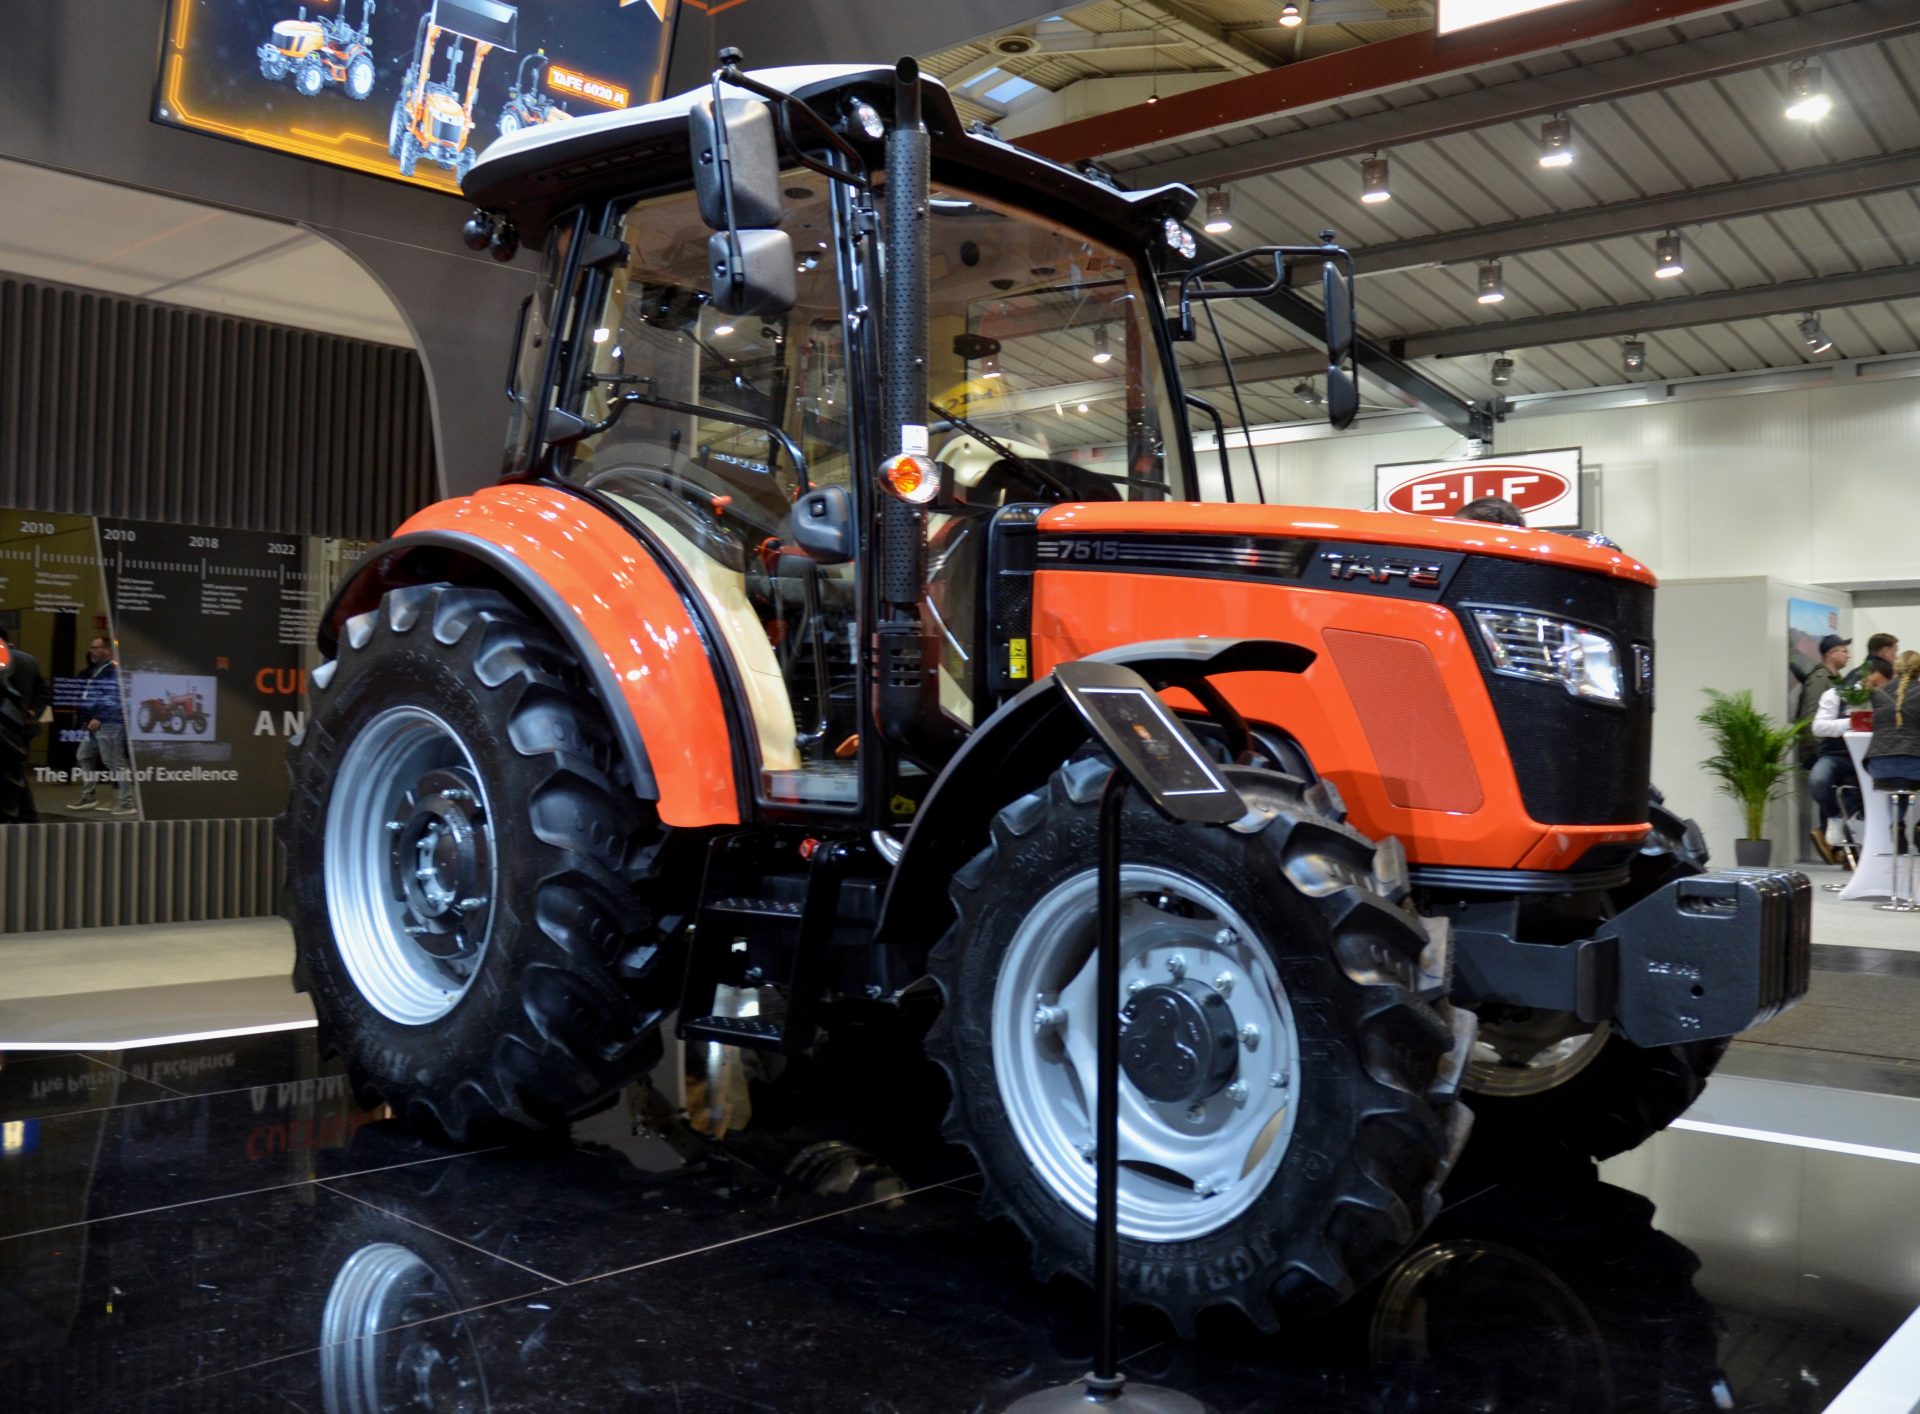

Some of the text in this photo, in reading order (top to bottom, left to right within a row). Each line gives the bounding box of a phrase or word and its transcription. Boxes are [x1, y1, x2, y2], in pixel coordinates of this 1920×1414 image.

[552, 70, 583, 91] TAFE
[583, 82, 613, 101] 6020
[19, 521, 55, 535] 2010
[103, 528, 136, 542] 2010
[188, 536, 220, 549] 2018
[267, 543, 296, 556] 2022
[1058, 540, 1119, 561] 7515
[1320, 551, 1443, 589] TAFE
[253, 710, 276, 736] A
[34, 766, 239, 783] The Pursuit of Excellence
